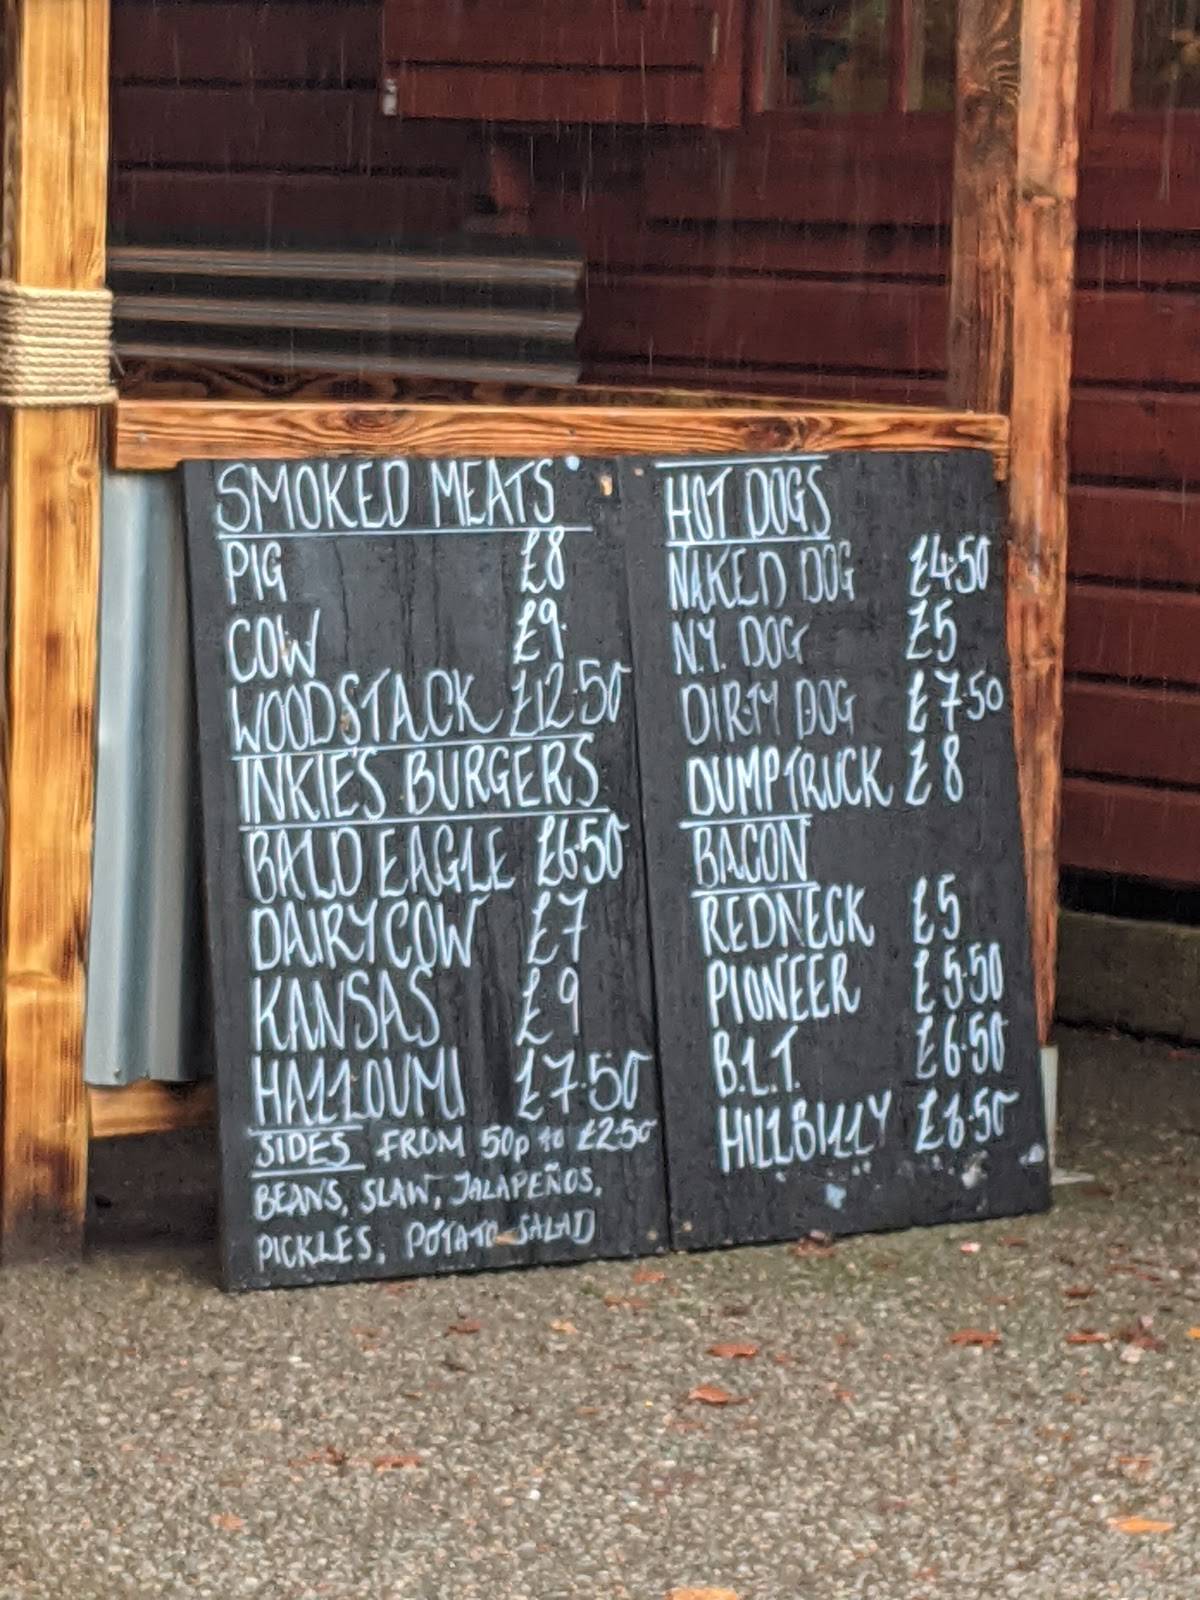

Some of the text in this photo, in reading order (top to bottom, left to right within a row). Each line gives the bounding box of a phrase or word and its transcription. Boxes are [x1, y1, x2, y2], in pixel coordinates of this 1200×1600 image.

[217, 458, 556, 533] SMOKED MEATS
[666, 464, 832, 542] HOT DOGS
[225, 541, 287, 604] PIG
[519, 527, 566, 594] £8
[667, 538, 857, 614] NAKED DOG
[227, 608, 321, 683] COW
[738, 615, 811, 669] DOG
[906, 599, 957, 662] £5
[228, 667, 504, 753] WOODSTACK
[682, 677, 858, 745] DIRTY DOG
[405, 733, 600, 815] BURGERS
[247, 825, 515, 902] BALD EAGLE
[694, 819, 812, 888] BACON
[701, 884, 875, 956] REDNECK
[252, 967, 441, 1052] KANSAS
[706, 952, 861, 1028] PIONEER
[251, 1046, 466, 1126] HALLOUMI
[256, 1132, 352, 1169] SIDES
[375, 1127, 465, 1163] FROM
[480, 1126, 529, 1164] 50p
[719, 1089, 892, 1174] HILLBILLY
[406, 1220, 498, 1258] POTATO
[515, 1208, 596, 1247] SALAD
